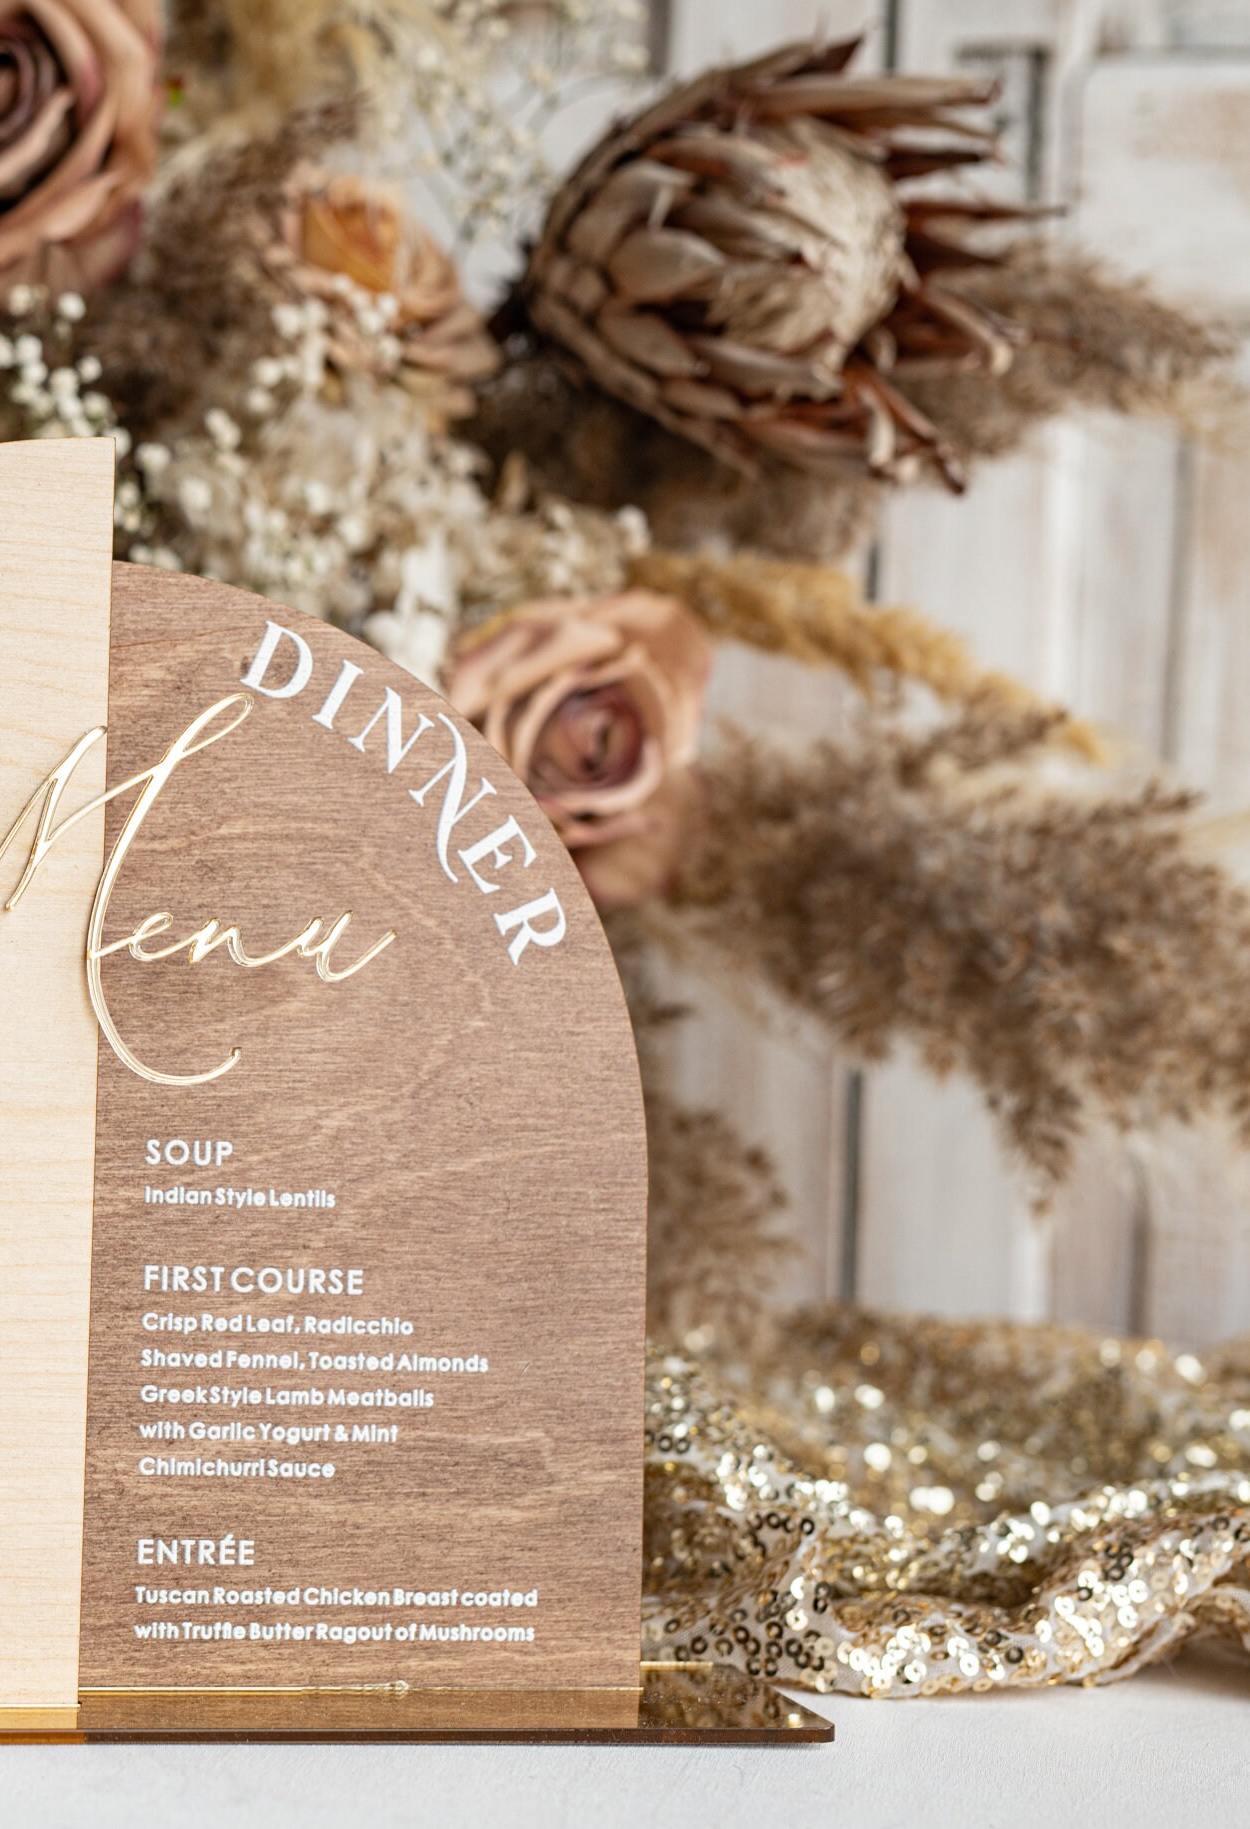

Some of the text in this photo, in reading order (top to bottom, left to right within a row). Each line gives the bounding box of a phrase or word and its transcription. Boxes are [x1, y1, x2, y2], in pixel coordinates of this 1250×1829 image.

[239, 620, 568, 966] DINNER
[144, 1138, 234, 1167] SOUP
[144, 1185, 336, 1209] Indian Style Lentils
[144, 1264, 364, 1296] FIRST COURSE
[141, 1312, 414, 1336] Crisp Red Leaf, Radicchio
[140, 1348, 489, 1373] Shaved Fennel, Toasted Almonds
[140, 1384, 435, 1408] Greek Style Lamb Meatballs
[139, 1421, 186, 1440] with
[188, 1421, 256, 1442] Garlic
[258, 1422, 331, 1446] Yogurt
[351, 1423, 399, 1443] Mint
[138, 1455, 336, 1478] Chimichurri Sauce
[137, 1533, 255, 1566] ENTRÉE
[135, 1586, 538, 1607] Tuscan Roasted Chicken Breast coated
[133, 1621, 536, 1645] with Truffle Butter Ragout of Mushrooms
